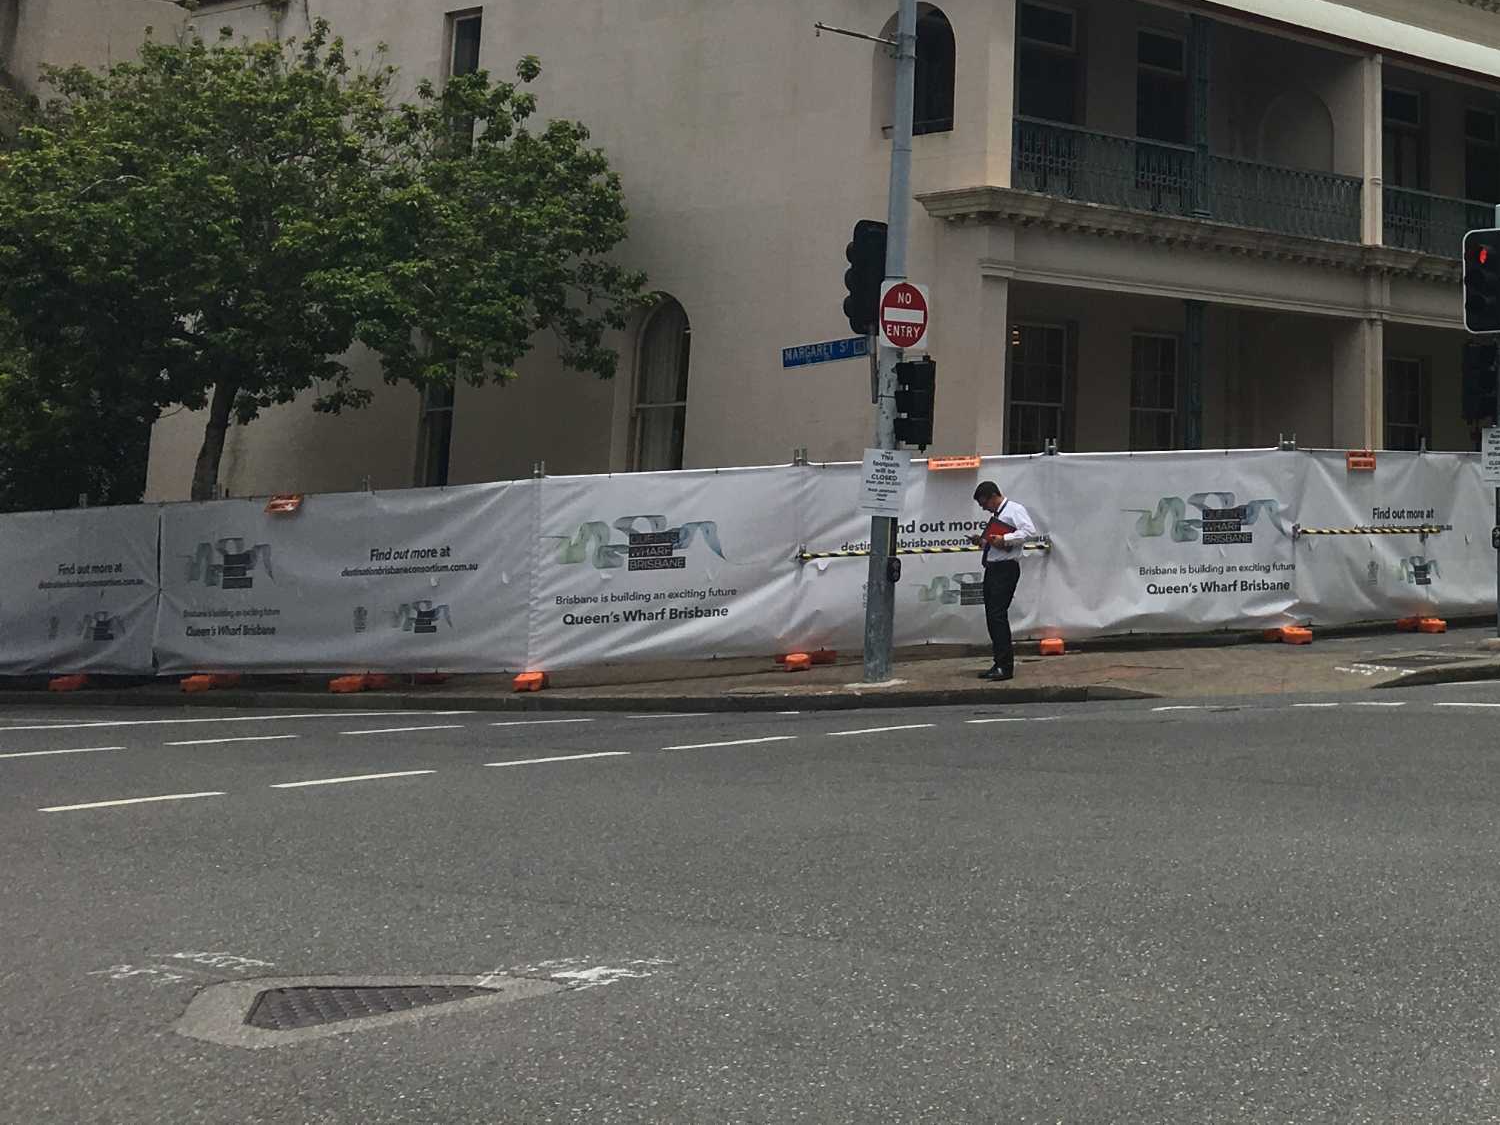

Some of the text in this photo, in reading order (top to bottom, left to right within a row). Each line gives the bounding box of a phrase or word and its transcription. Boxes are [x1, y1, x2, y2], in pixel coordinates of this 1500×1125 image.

[897, 292, 912, 305] NO
[886, 324, 921, 338] ENTRY
[784, 343, 833, 362] MARGARET
[871, 473, 898, 481] CLOSED
[1372, 507, 1434, 520] Find out more at
[919, 521, 945, 533] out
[948, 520, 988, 531] more
[369, 546, 451, 562] Find out more at
[629, 557, 685, 570] BRISBANE
[1139, 566, 1178, 576] Brisbane
[1179, 566, 1187, 575] is
[1188, 564, 1224, 575] building
[1238, 563, 1271, 574] exciting
[1146, 578, 1290, 595] Queen's Wharf Brisbane
[555, 587, 737, 605] Brisbane is building an exciting future
[562, 606, 729, 626] Queen's Wharf Brisbane
[185, 624, 276, 637] Queen's Wharf Brisbane
